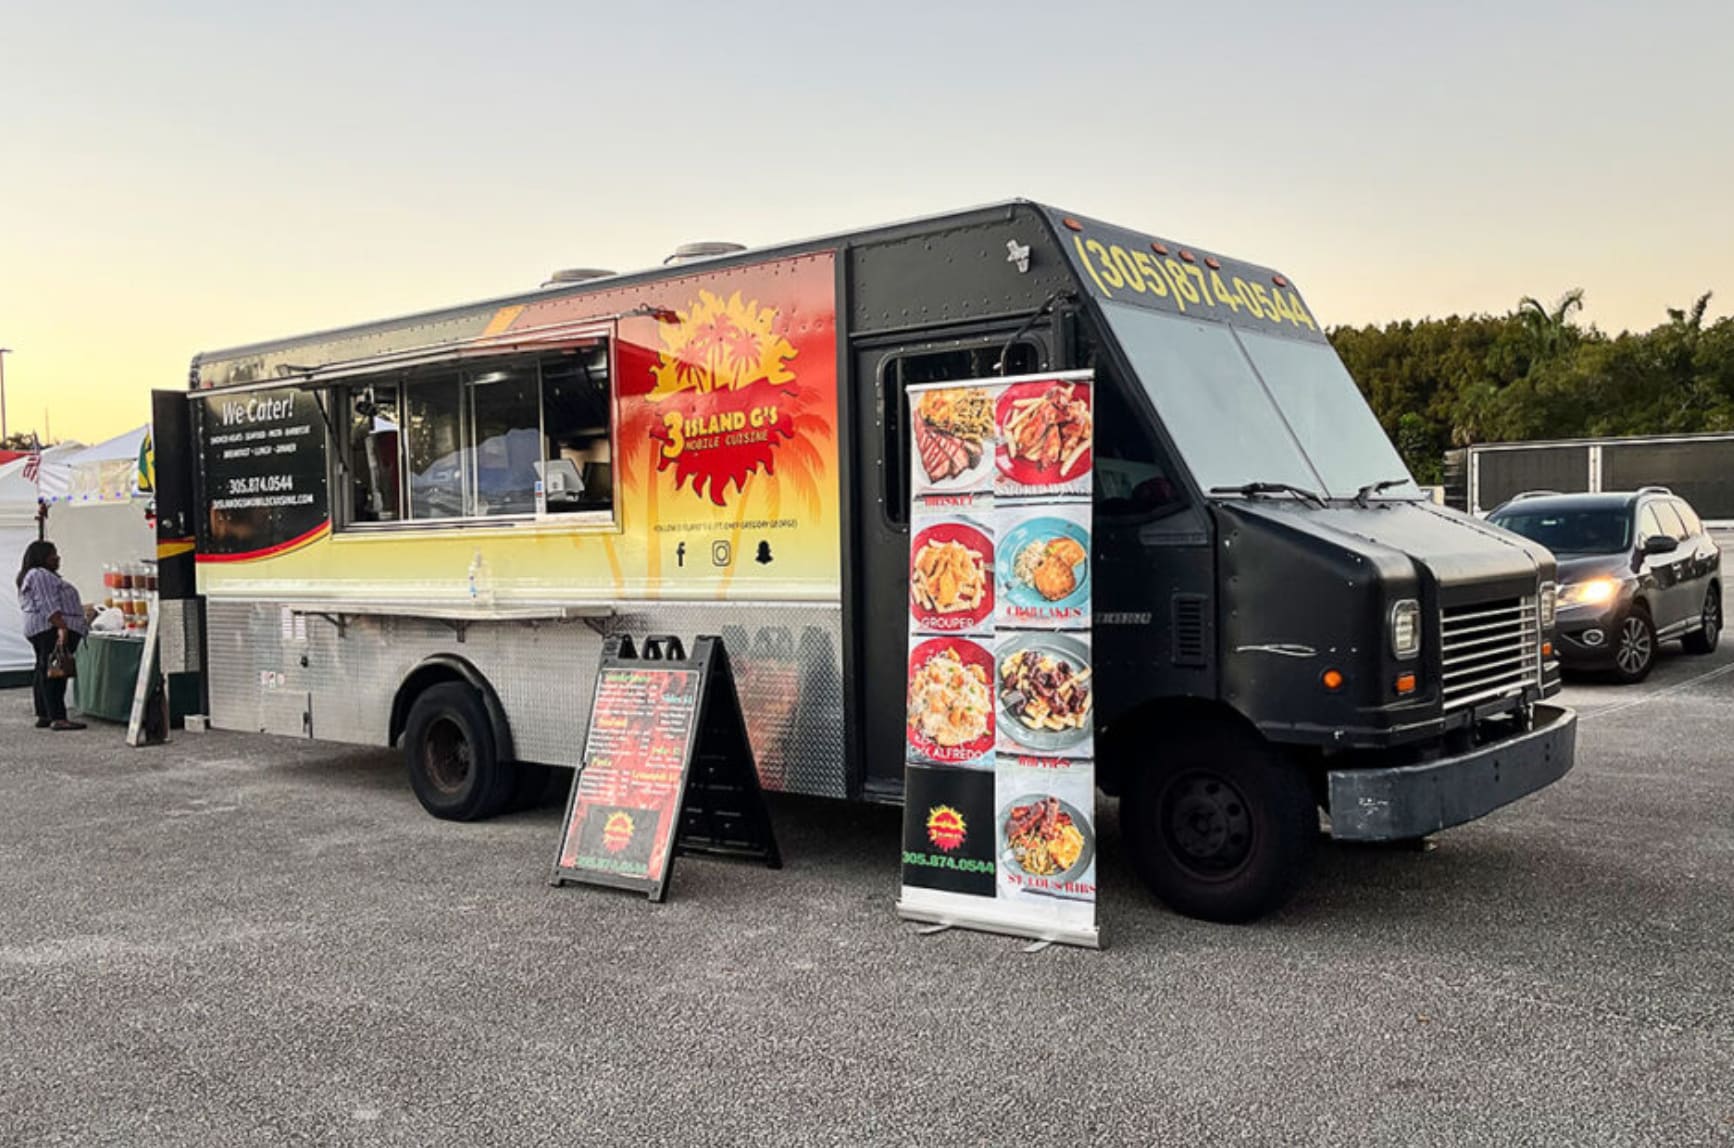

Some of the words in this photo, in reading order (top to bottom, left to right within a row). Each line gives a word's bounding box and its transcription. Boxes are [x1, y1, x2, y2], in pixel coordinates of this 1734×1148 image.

[1073, 235, 1316, 331] (305)874-0544
[223, 401, 245, 426] We
[247, 392, 295, 422] Cater!
[662, 411, 685, 458] 3
[685, 411, 746, 437] ISLAND
[750, 405, 778, 428] G'S
[685, 437, 720, 450] MOBILE
[724, 431, 768, 446] CUISINE
[229, 475, 293, 495] 305.874.0544
[921, 616, 976, 631] GROUPER
[933, 747, 984, 760] ALFREDO
[902, 851, 994, 874] 305.874.0544
